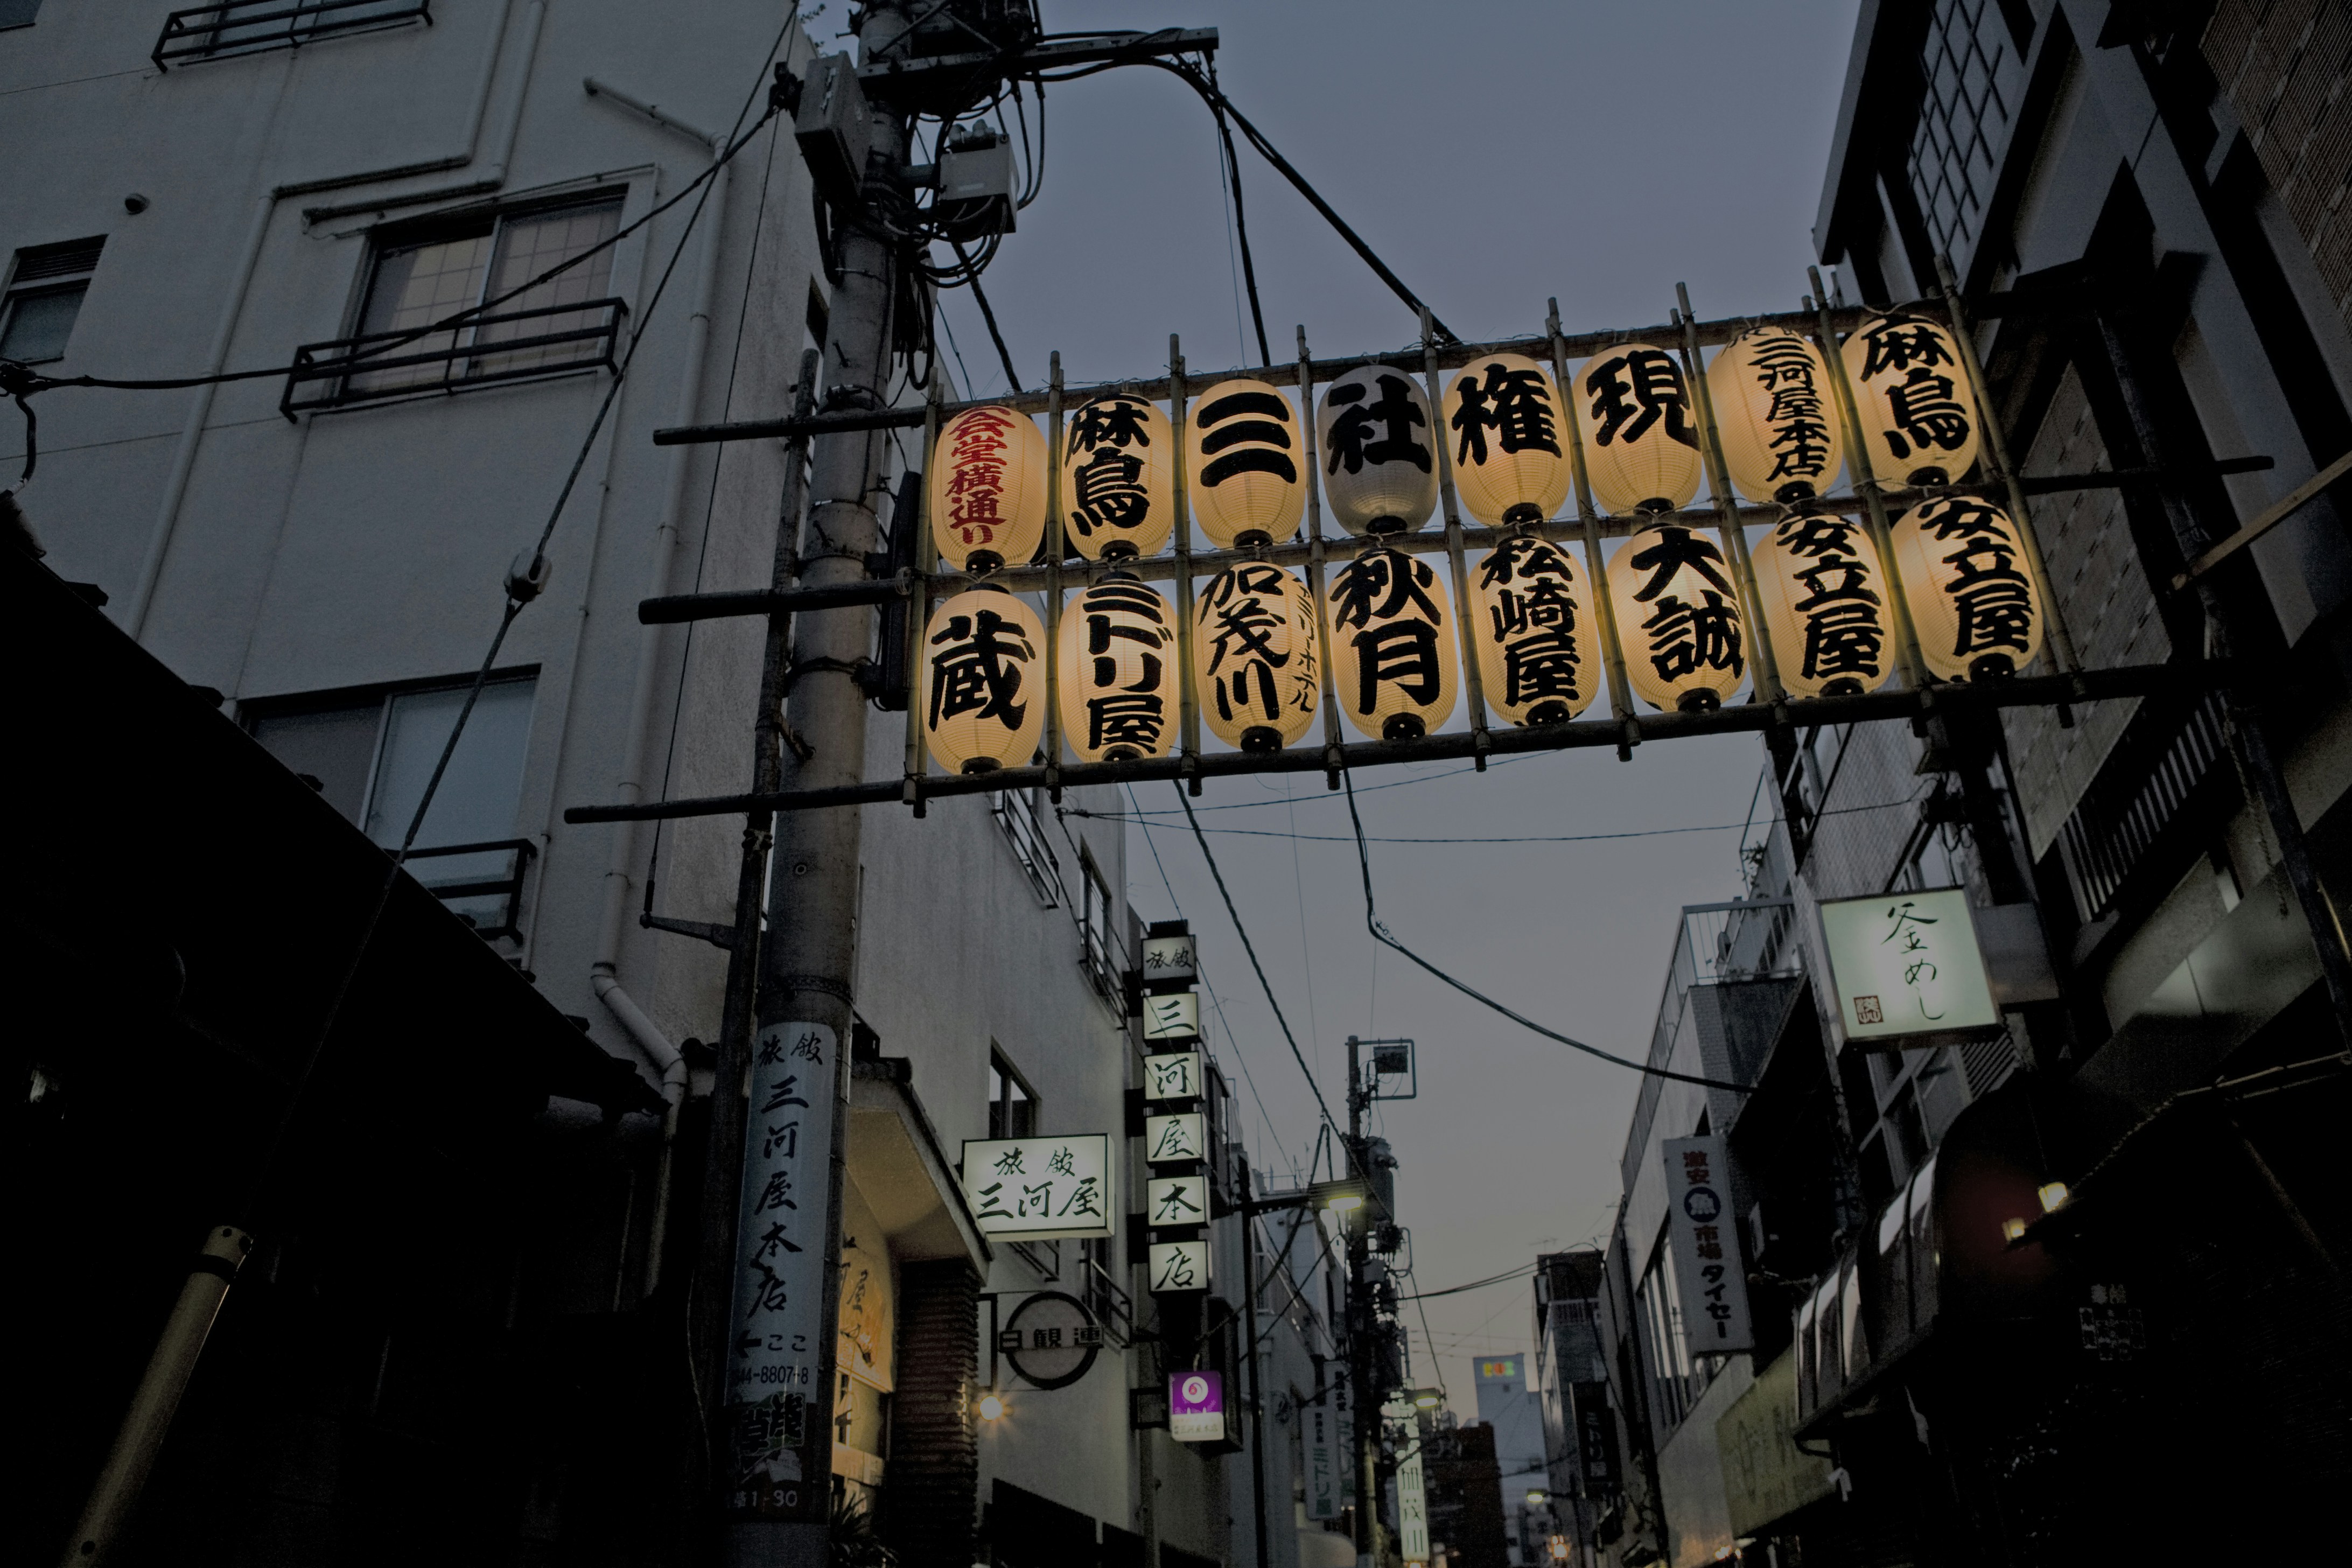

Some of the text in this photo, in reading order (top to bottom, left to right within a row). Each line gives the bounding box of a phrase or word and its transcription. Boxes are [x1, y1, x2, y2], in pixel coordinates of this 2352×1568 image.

[945, 407, 1016, 545] 会堂横通り
[1197, 350, 1703, 487] 三 社 権 現
[1748, 337, 1830, 481] 三河屋本店
[928, 611, 1036, 732] 蔵
[1083, 580, 1174, 753] ミドリ屋
[1199, 565, 1291, 722] 加茂川
[1290, 576, 1318, 713] ァミリーホテル
[1329, 548, 1441, 715] 秋月
[1881, 902, 1946, 1020] 釜めし
[748, 1075, 809, 1319] 三河屋本店
[977, 1177, 1101, 1219] 三河屋
[1149, 999, 1202, 1290] 三河屋本店
[768, 1334, 806, 1352] ここ
[999, 1327, 1101, 1350] 日観連
